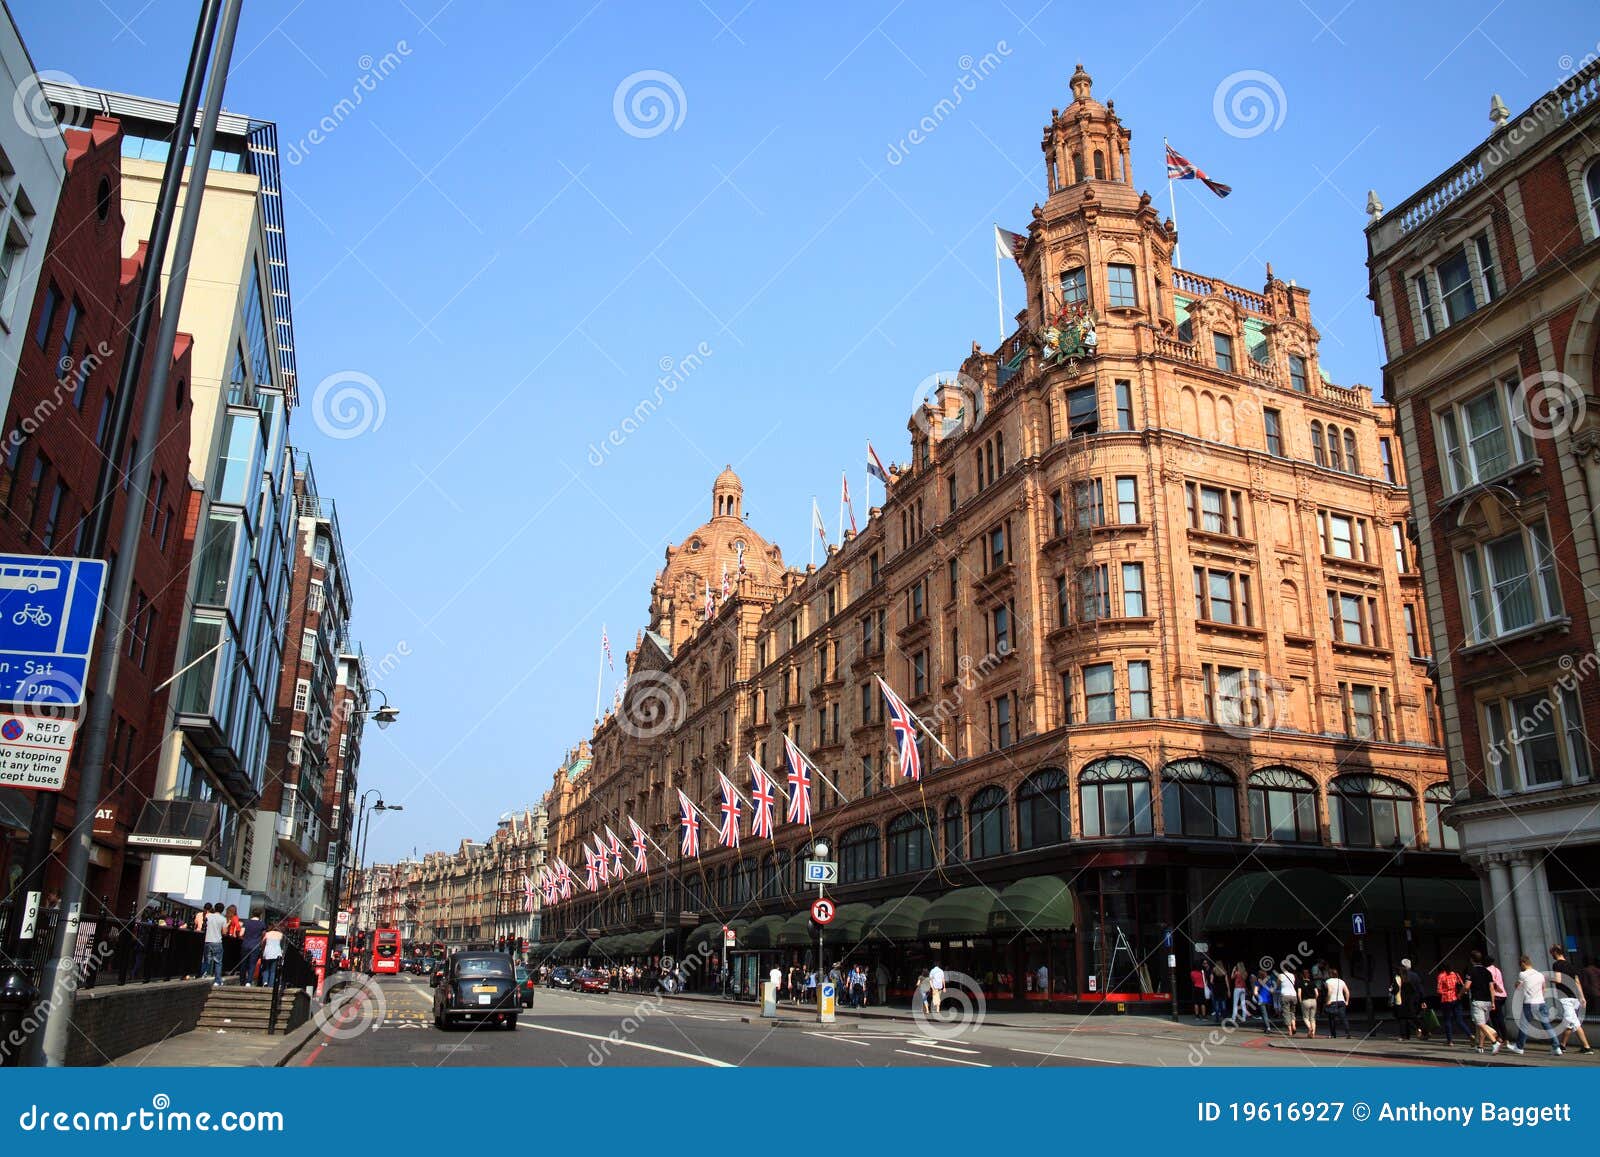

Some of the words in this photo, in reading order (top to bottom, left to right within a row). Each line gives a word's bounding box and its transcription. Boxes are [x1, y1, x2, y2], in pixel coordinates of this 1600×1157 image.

[23, 660, 54, 675] Sat
[37, 722, 61, 733] RED
[26, 732, 67, 745] ROUTE
[15, 750, 62, 764] stopping
[10, 762, 29, 772] any
[33, 763, 57, 773] time
[0, 772, 25, 782] cept
[28, 773, 60, 785] buses
[94, 808, 114, 820] AT.
